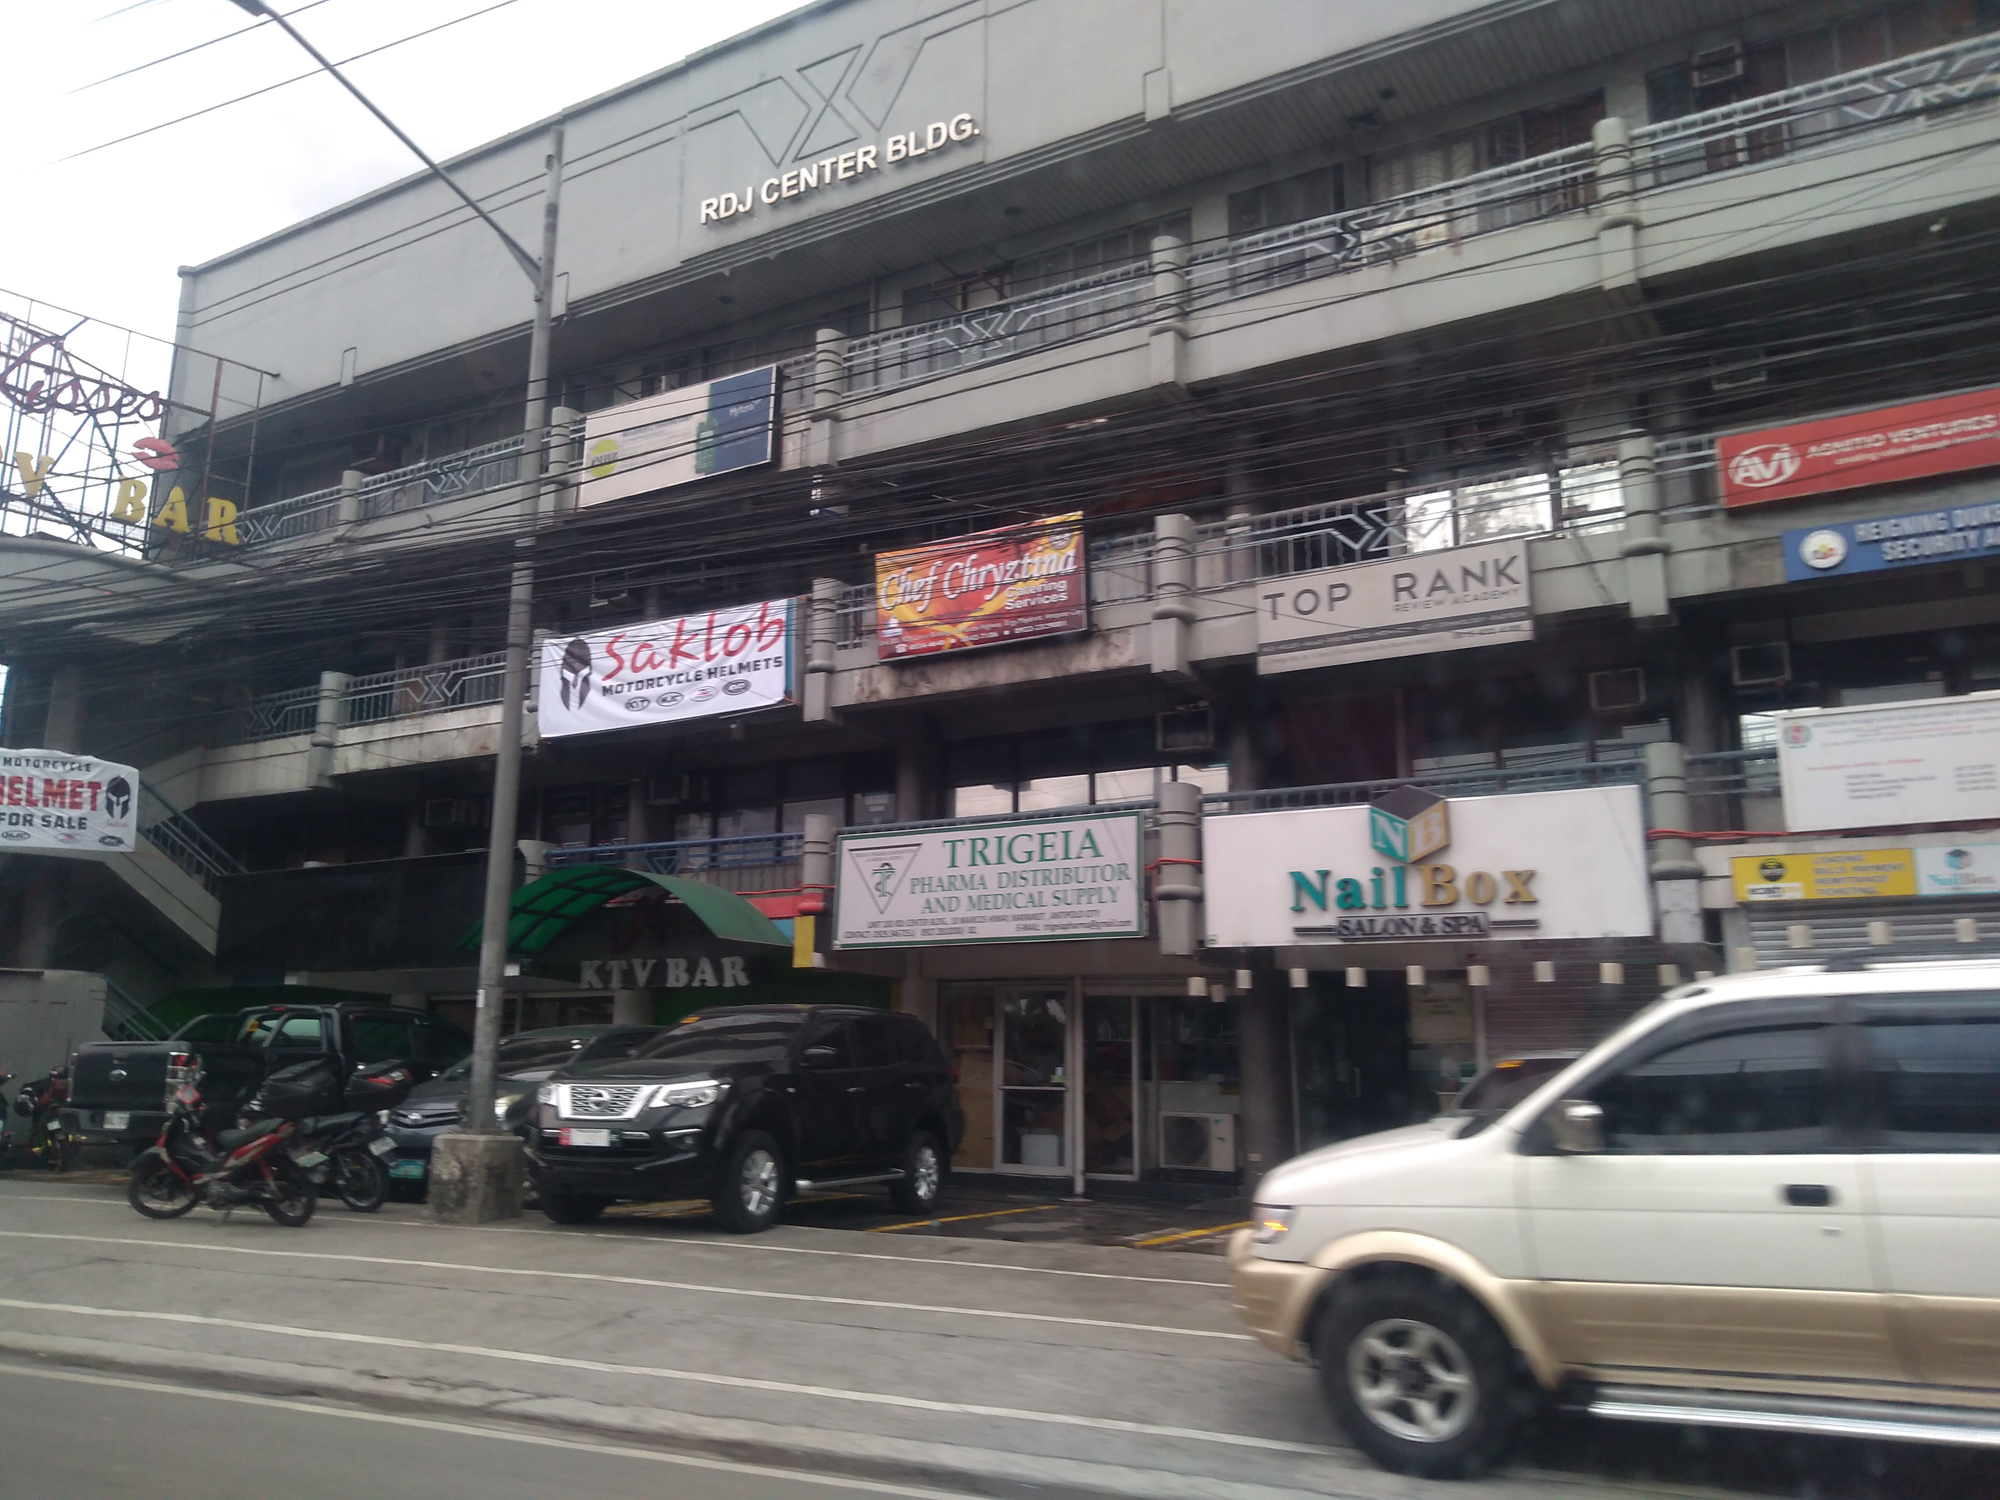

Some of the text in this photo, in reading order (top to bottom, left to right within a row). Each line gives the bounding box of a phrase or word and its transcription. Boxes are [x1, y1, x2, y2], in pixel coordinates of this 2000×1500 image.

[700, 113, 981, 225] RDJ CENTER BLDG.
[110, 475, 241, 546] BAR
[1882, 530, 1979, 562] SECURITY
[880, 561, 943, 613] Chef
[1005, 580, 1068, 600] Catering
[1005, 592, 1069, 610] Services
[1262, 555, 1521, 620] TOP RANK
[601, 602, 785, 682] Saklob
[602, 669, 702, 697] MOTORCYCLE
[707, 655, 784, 679] HELMETS
[3, 757, 92, 772] MOTORCYCLE
[0, 775, 102, 811] ELMET
[41, 814, 88, 830] SALE
[943, 829, 1103, 868] TRIGEIA
[910, 863, 1131, 895] PHARMA DISTRIBUTOR
[921, 886, 1121, 914] AND MEDICAL SUPPLY
[1339, 916, 1418, 938] SALON
[1443, 914, 1487, 936] SPA
[580, 956, 749, 988] KTV BAR
